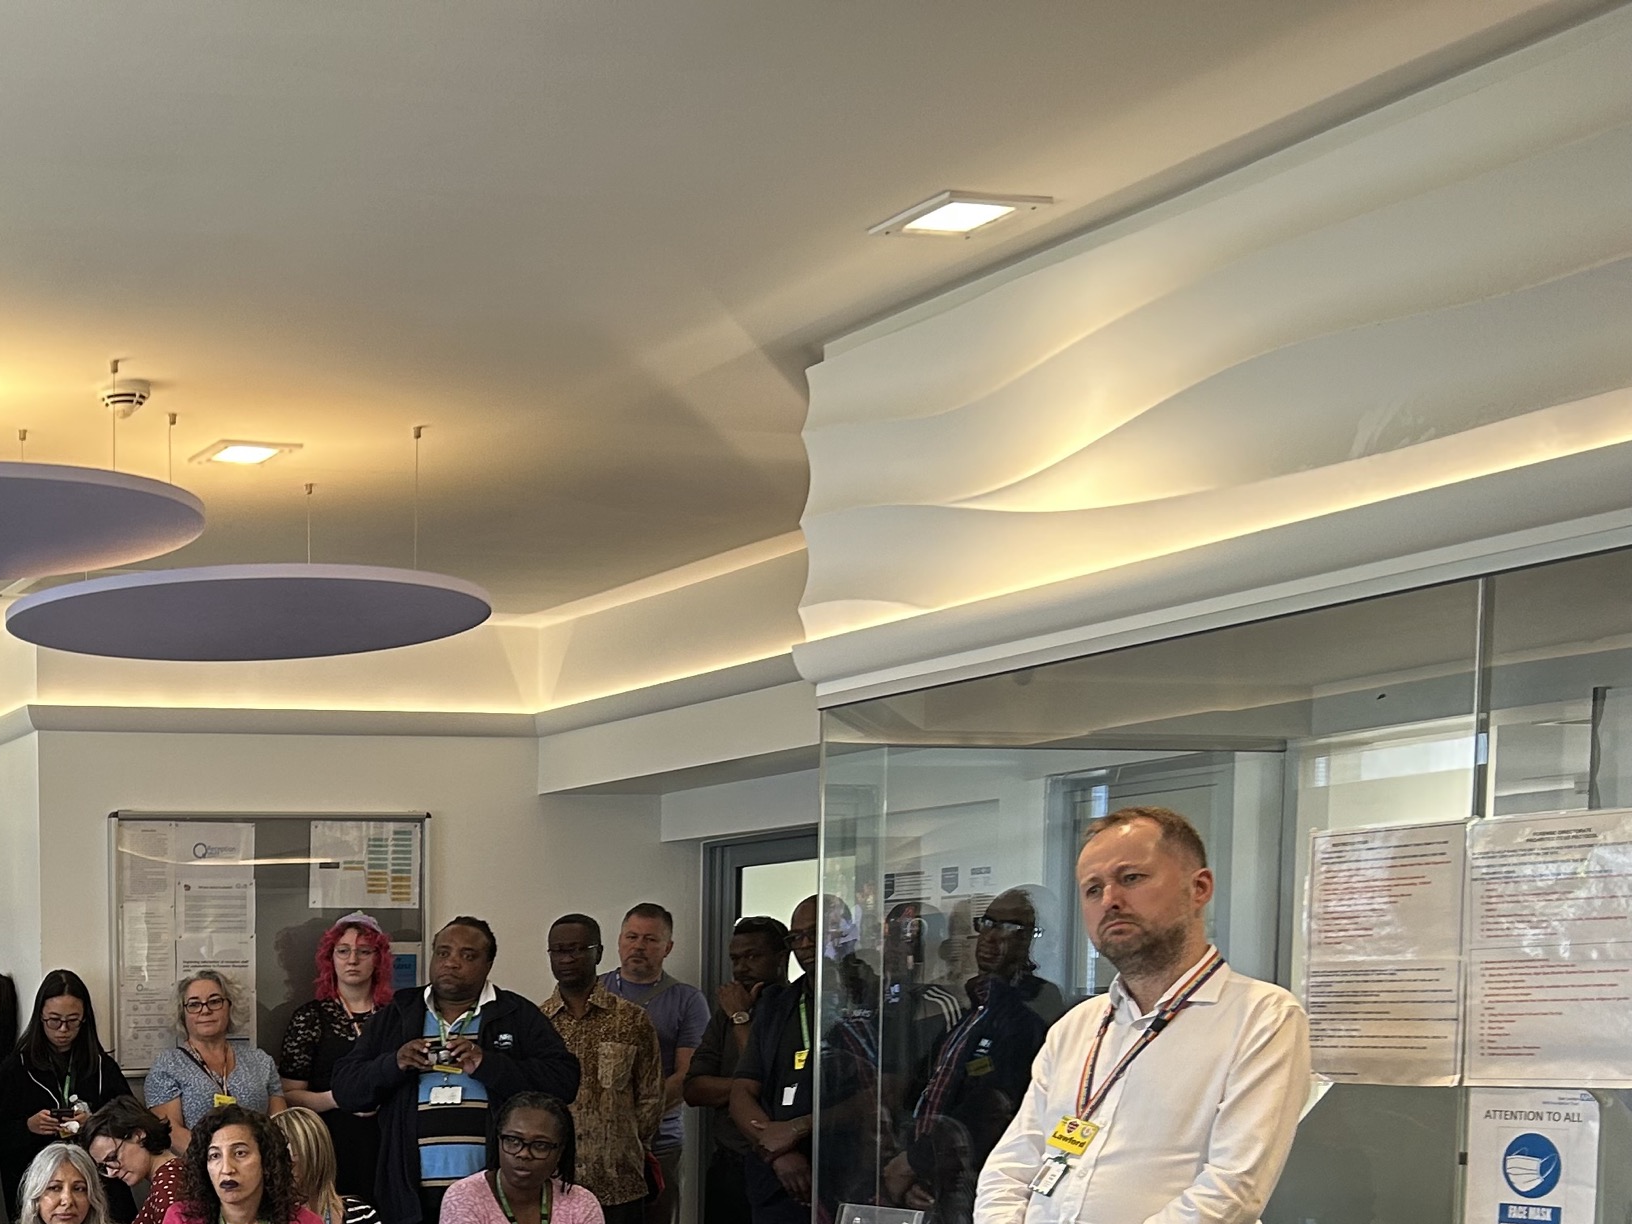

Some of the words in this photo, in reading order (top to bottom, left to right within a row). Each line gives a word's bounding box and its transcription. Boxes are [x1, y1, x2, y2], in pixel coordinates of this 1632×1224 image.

[1484, 1109, 1543, 1121] ATTENTION
[1546, 1111, 1561, 1122] TO
[1564, 1112, 1583, 1122] ALL
[1052, 1131, 1086, 1148] Lawford
[1508, 1205, 1528, 1219] FACE
[1528, 1207, 1552, 1221] MASK
